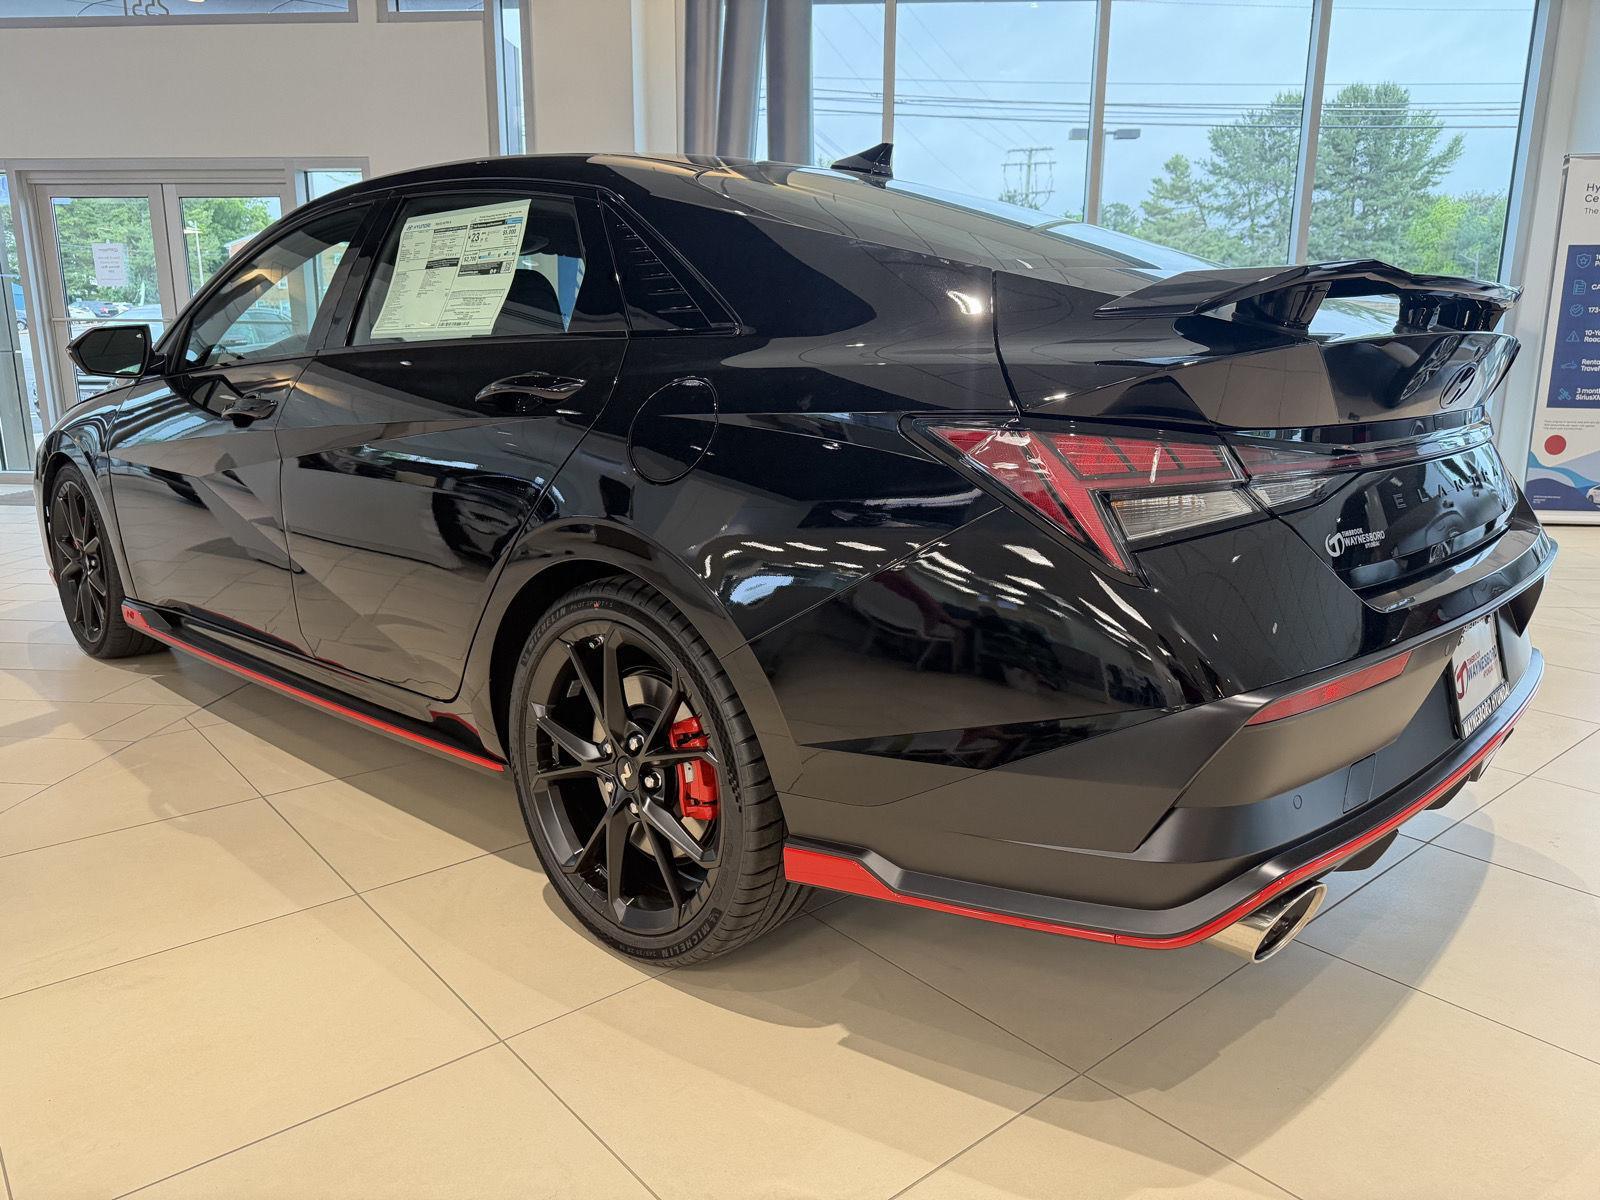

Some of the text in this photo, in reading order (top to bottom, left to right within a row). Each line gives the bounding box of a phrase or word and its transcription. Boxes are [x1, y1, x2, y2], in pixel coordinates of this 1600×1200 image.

[1584, 207, 1599, 215] The
[471, 232, 480, 242] 23
[1393, 466, 1498, 509] ELANTRA
[1343, 530, 1385, 547] WAYNESBORO
[662, 922, 710, 958] MICHELIN
